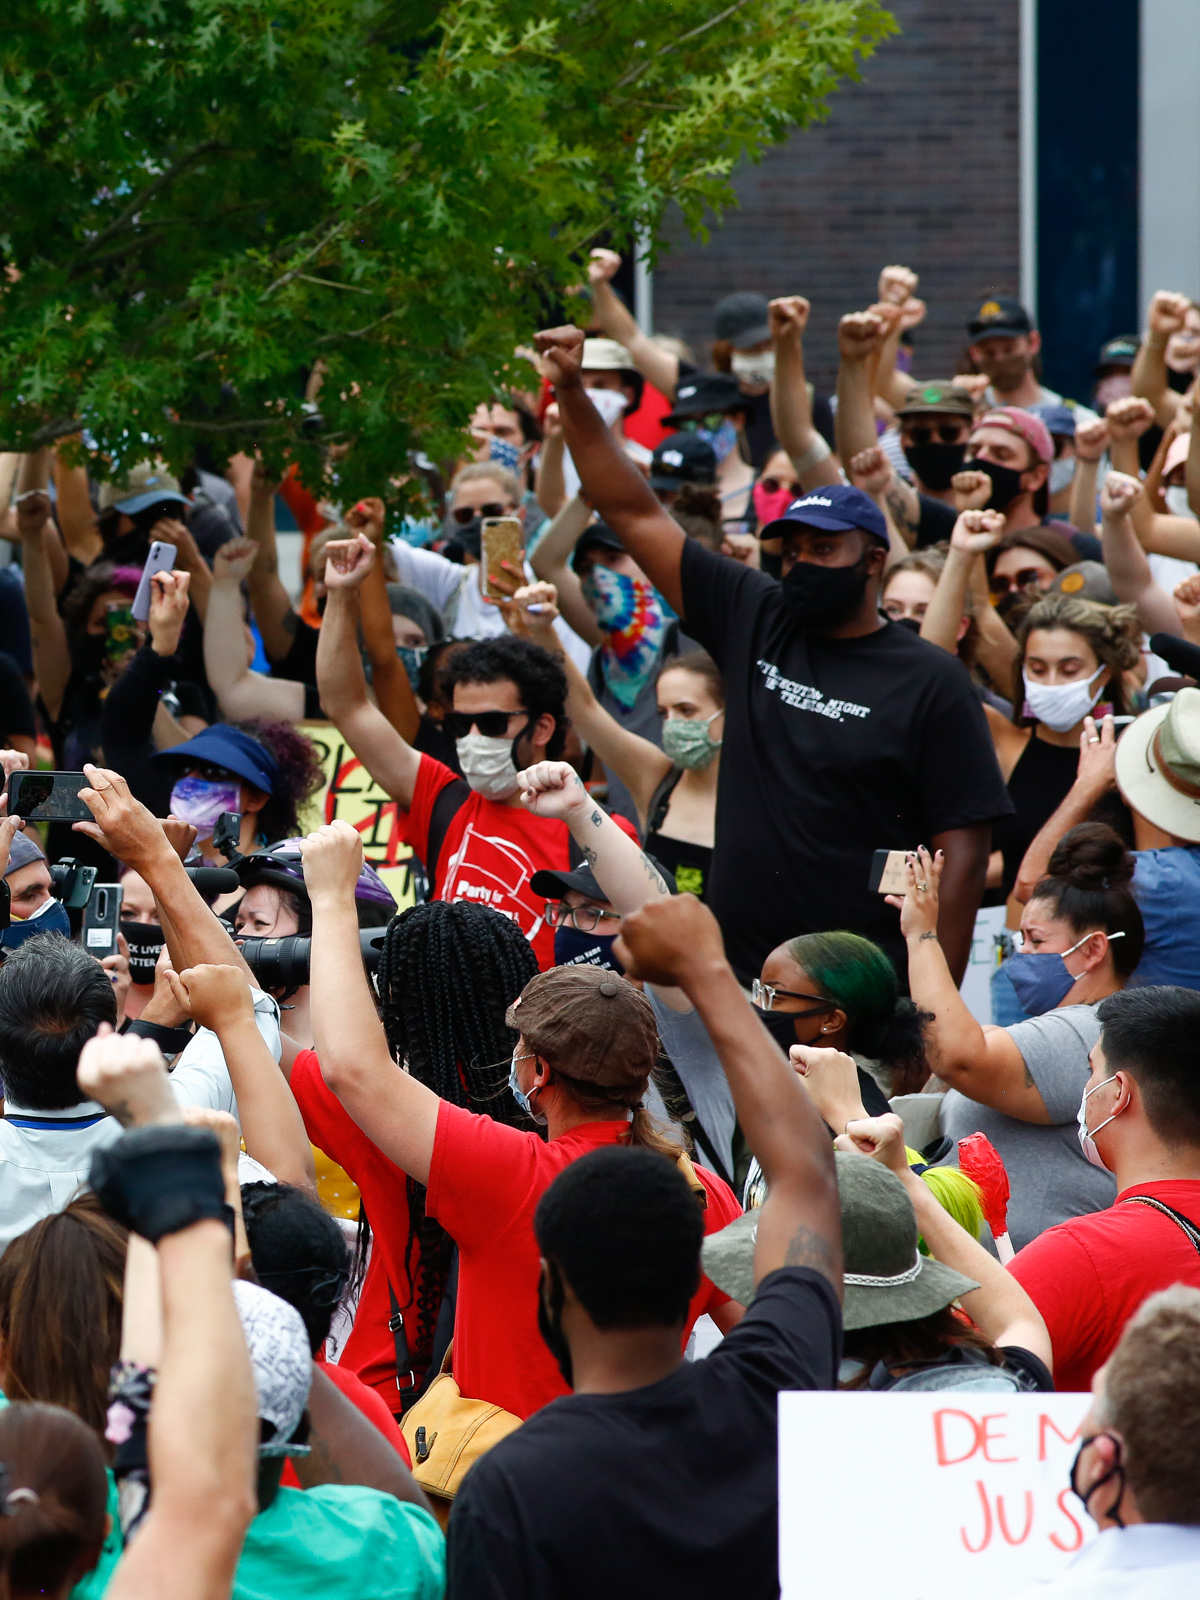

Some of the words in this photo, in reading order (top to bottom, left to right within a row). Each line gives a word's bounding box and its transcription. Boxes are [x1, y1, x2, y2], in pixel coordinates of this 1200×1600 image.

[827, 699, 871, 718] MIGHT
[456, 880, 492, 903] Party
[491, 889, 504, 903] for
[128, 957, 156, 967] ATTER
[584, 946, 602, 959] Name
[932, 1407, 1083, 1467] DEM
[960, 1479, 1084, 1553] JUS
